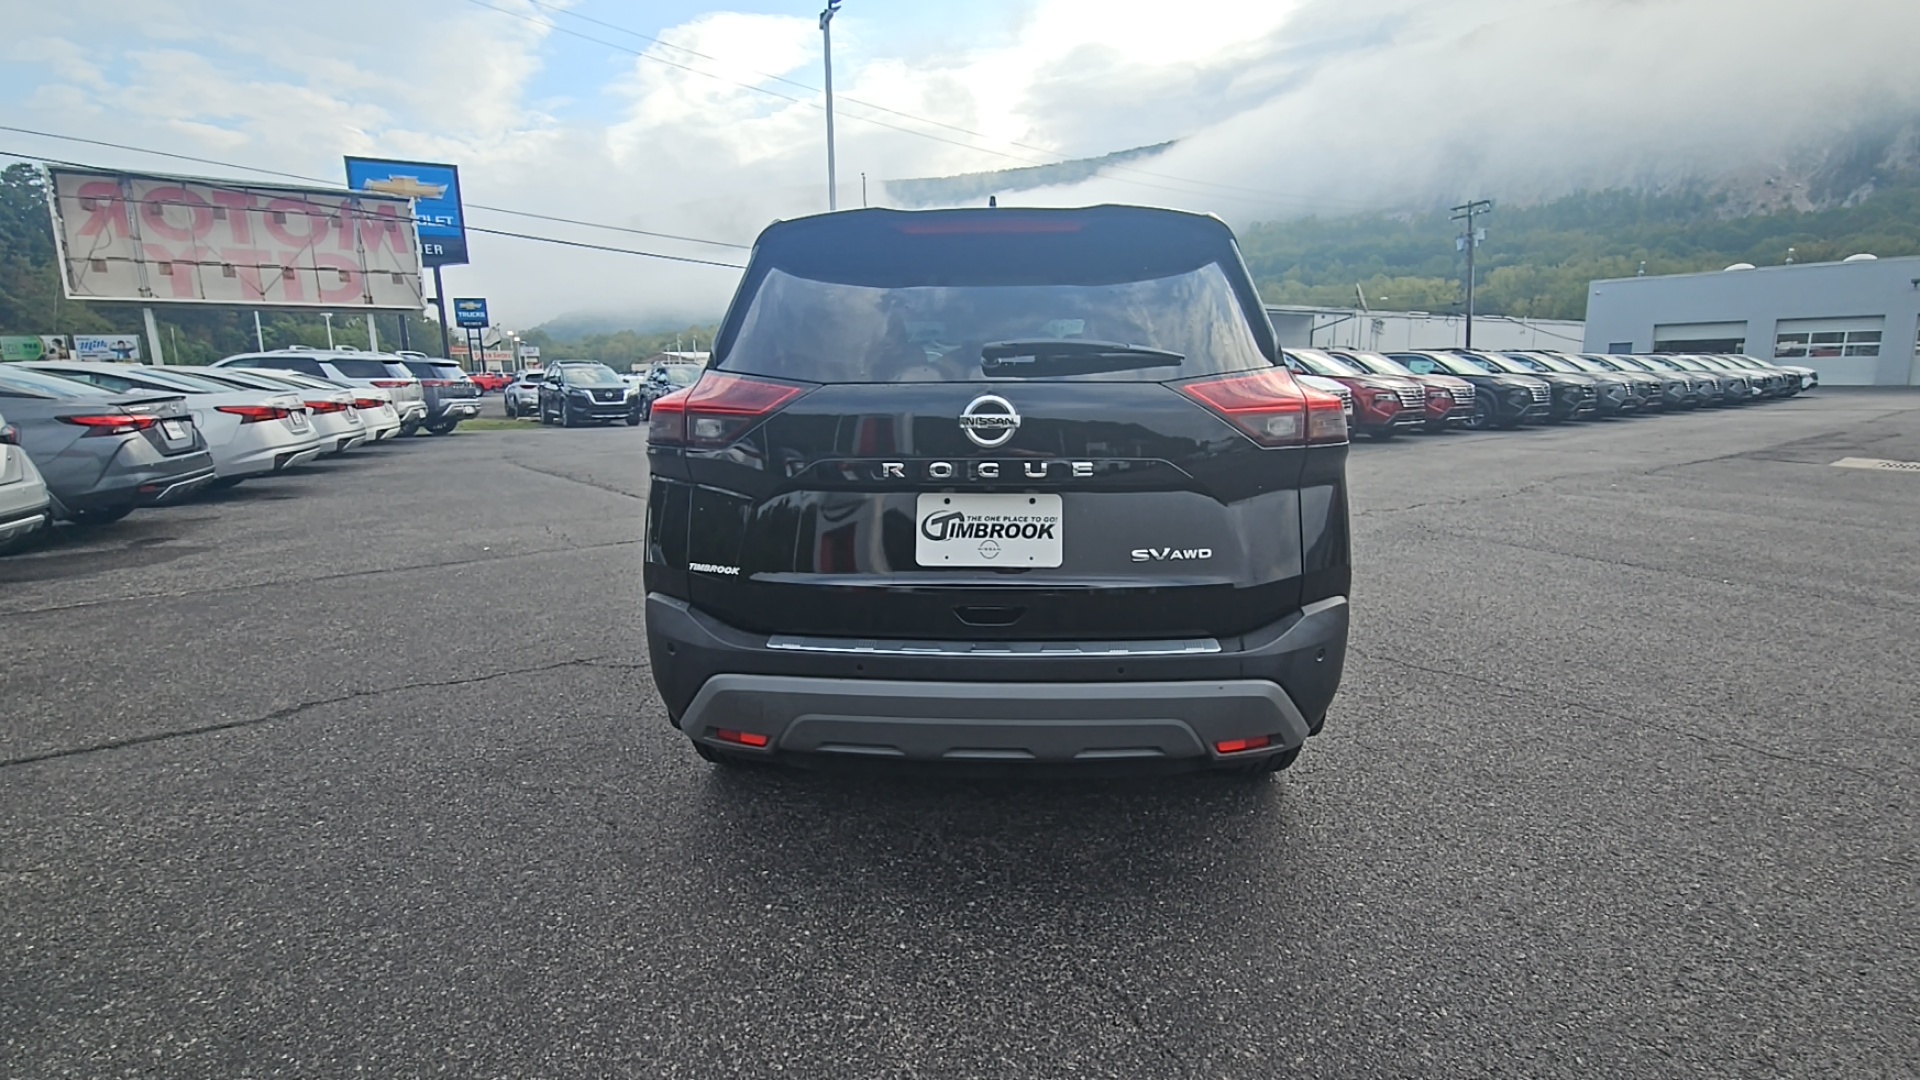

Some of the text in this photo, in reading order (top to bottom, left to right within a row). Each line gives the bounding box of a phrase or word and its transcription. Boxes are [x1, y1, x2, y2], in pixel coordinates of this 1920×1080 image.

[965, 416, 1017, 426] NISSAN
[881, 461, 1095, 478] ROGUE
[921, 510, 1056, 542] TIMBROOK
[688, 562, 740, 575] TIMBROOK
